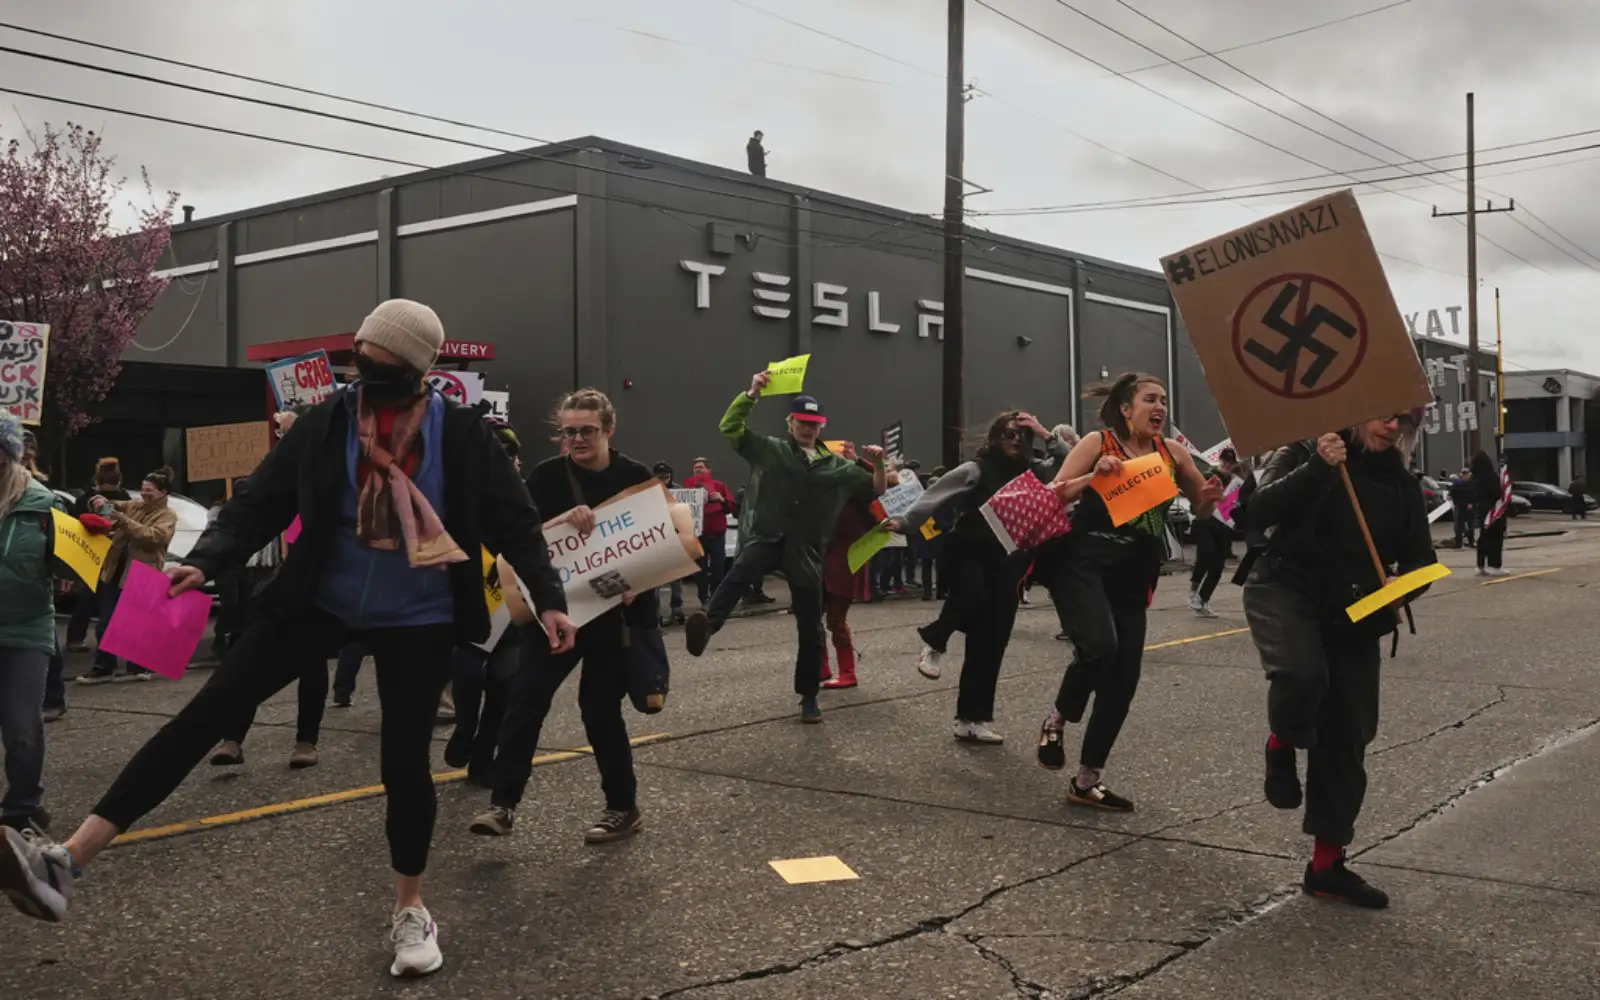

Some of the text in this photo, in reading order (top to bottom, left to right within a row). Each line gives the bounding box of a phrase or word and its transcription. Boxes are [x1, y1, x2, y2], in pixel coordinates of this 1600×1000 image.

[1168, 203, 1340, 285] #ELONISANAZI
[439, 342, 488, 356] IVERY
[294, 356, 333, 391] GRAB
[194, 440, 234, 462] OUT
[1103, 464, 1163, 502] UNELECTED
[596, 510, 635, 539] THE
[58, 525, 101, 567] UNELECTED
